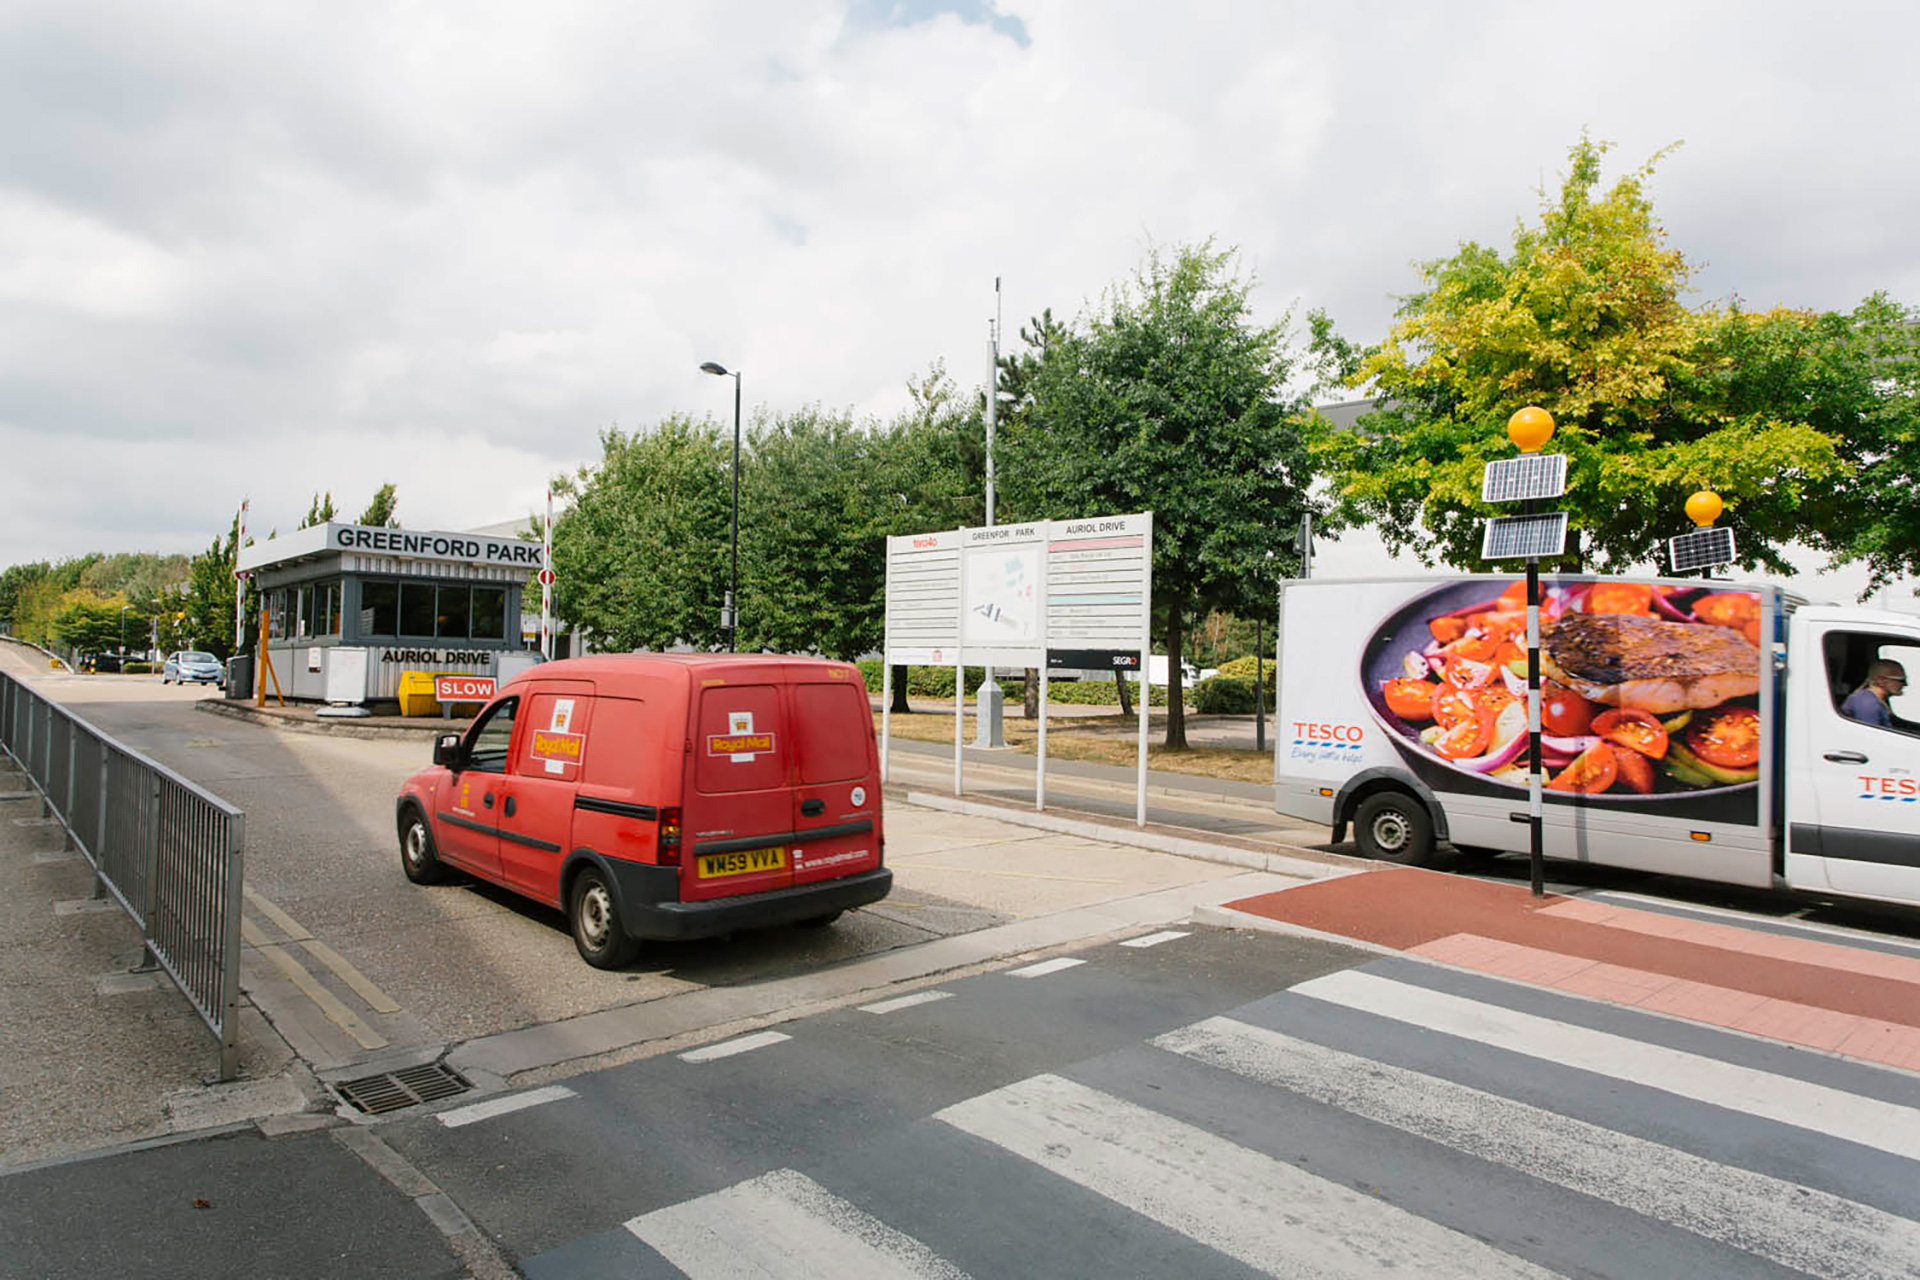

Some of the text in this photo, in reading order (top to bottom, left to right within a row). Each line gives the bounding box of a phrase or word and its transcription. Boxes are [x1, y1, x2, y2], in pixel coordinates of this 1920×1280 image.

[1015, 528, 1035, 538] PARK
[1066, 521, 1126, 534] AURIOL DRIVE
[337, 528, 542, 564] GREENFORD PARK
[381, 650, 491, 664] AURIOL DRIVE
[1112, 656, 1137, 665] SEGRO
[440, 682, 492, 695] SLOW
[1291, 721, 1363, 742] TESCO
[535, 733, 581, 756] Royal Mail
[712, 736, 770, 752] Royal Mail
[1857, 776, 1920, 795] TES
